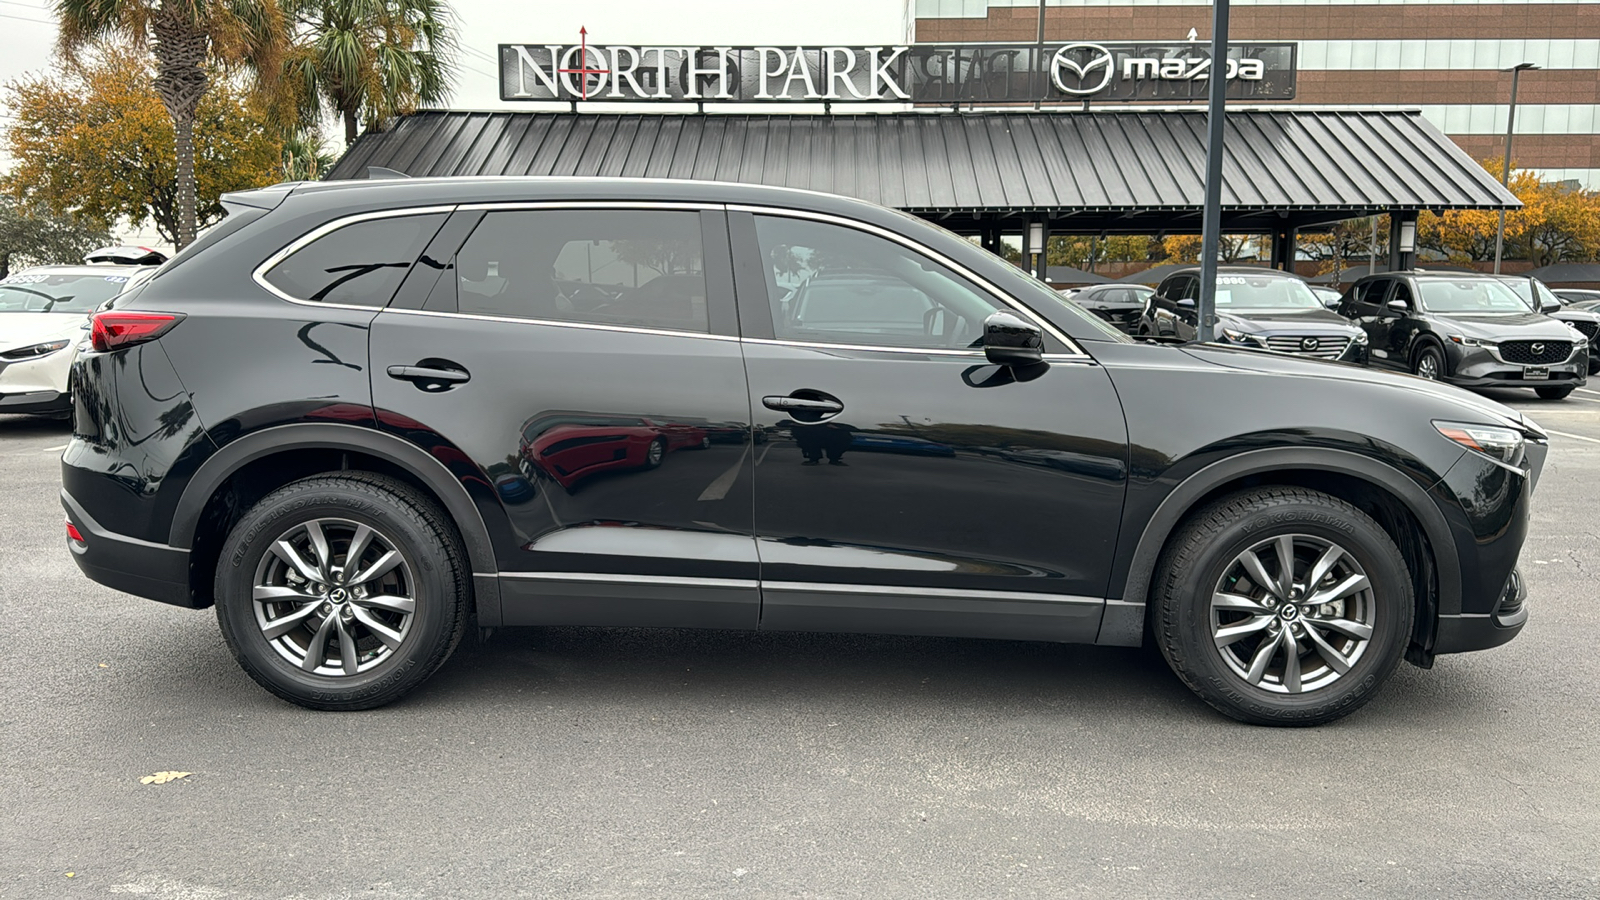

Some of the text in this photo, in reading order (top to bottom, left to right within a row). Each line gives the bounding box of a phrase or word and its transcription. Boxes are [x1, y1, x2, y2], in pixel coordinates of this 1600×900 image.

[511, 45, 736, 99] NORTH
[753, 45, 911, 99] PARK
[1241, 510, 1355, 534] YOKOHAMA
[311, 658, 416, 701] YOKOHAMA
[1249, 674, 1376, 719] GEOLANDAR
